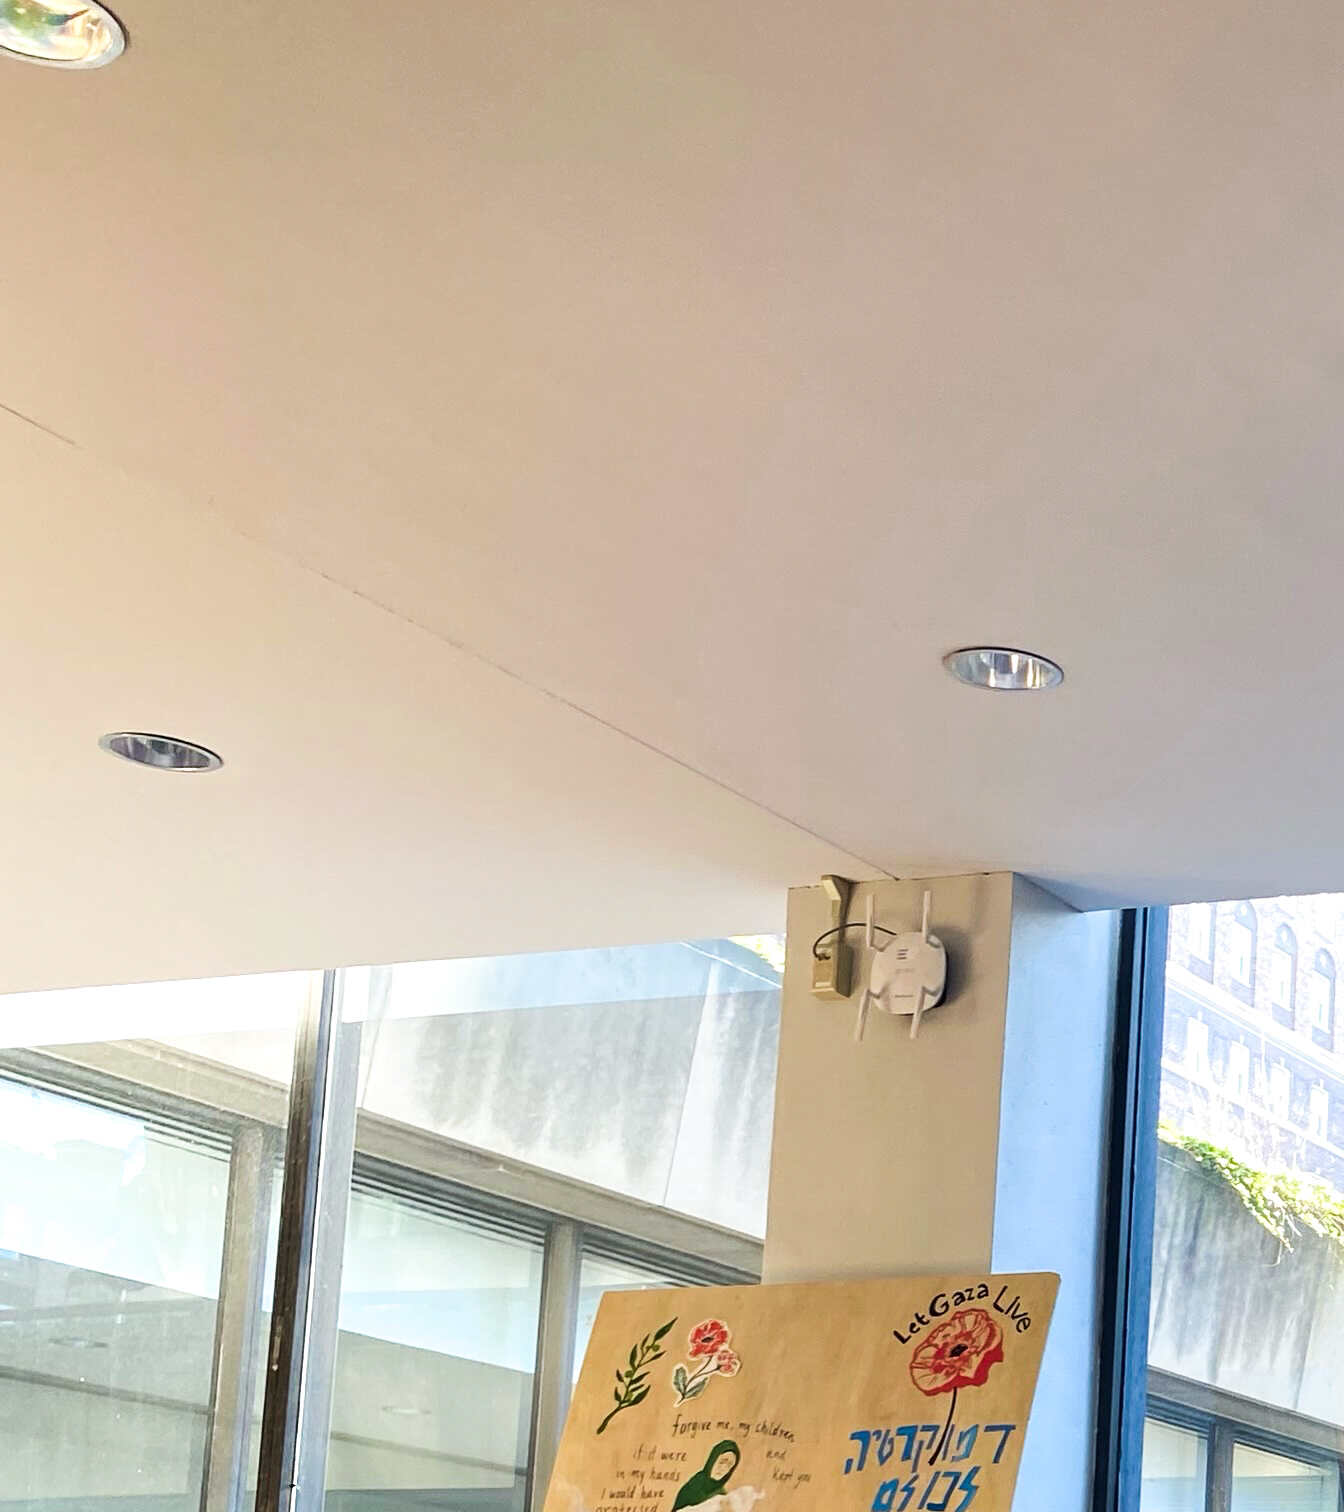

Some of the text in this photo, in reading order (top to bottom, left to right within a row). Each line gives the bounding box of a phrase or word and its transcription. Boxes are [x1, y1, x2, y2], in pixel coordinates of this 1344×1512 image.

[893, 1283, 1032, 1345] Let Gaza Live
[739, 1421, 750, 1437] my
[844, 1423, 1017, 1475] דמוקרטיה
[661, 1453, 688, 1462] were
[631, 1471, 645, 1484] my
[609, 1487, 635, 1499] would
[641, 1488, 665, 1499] have
